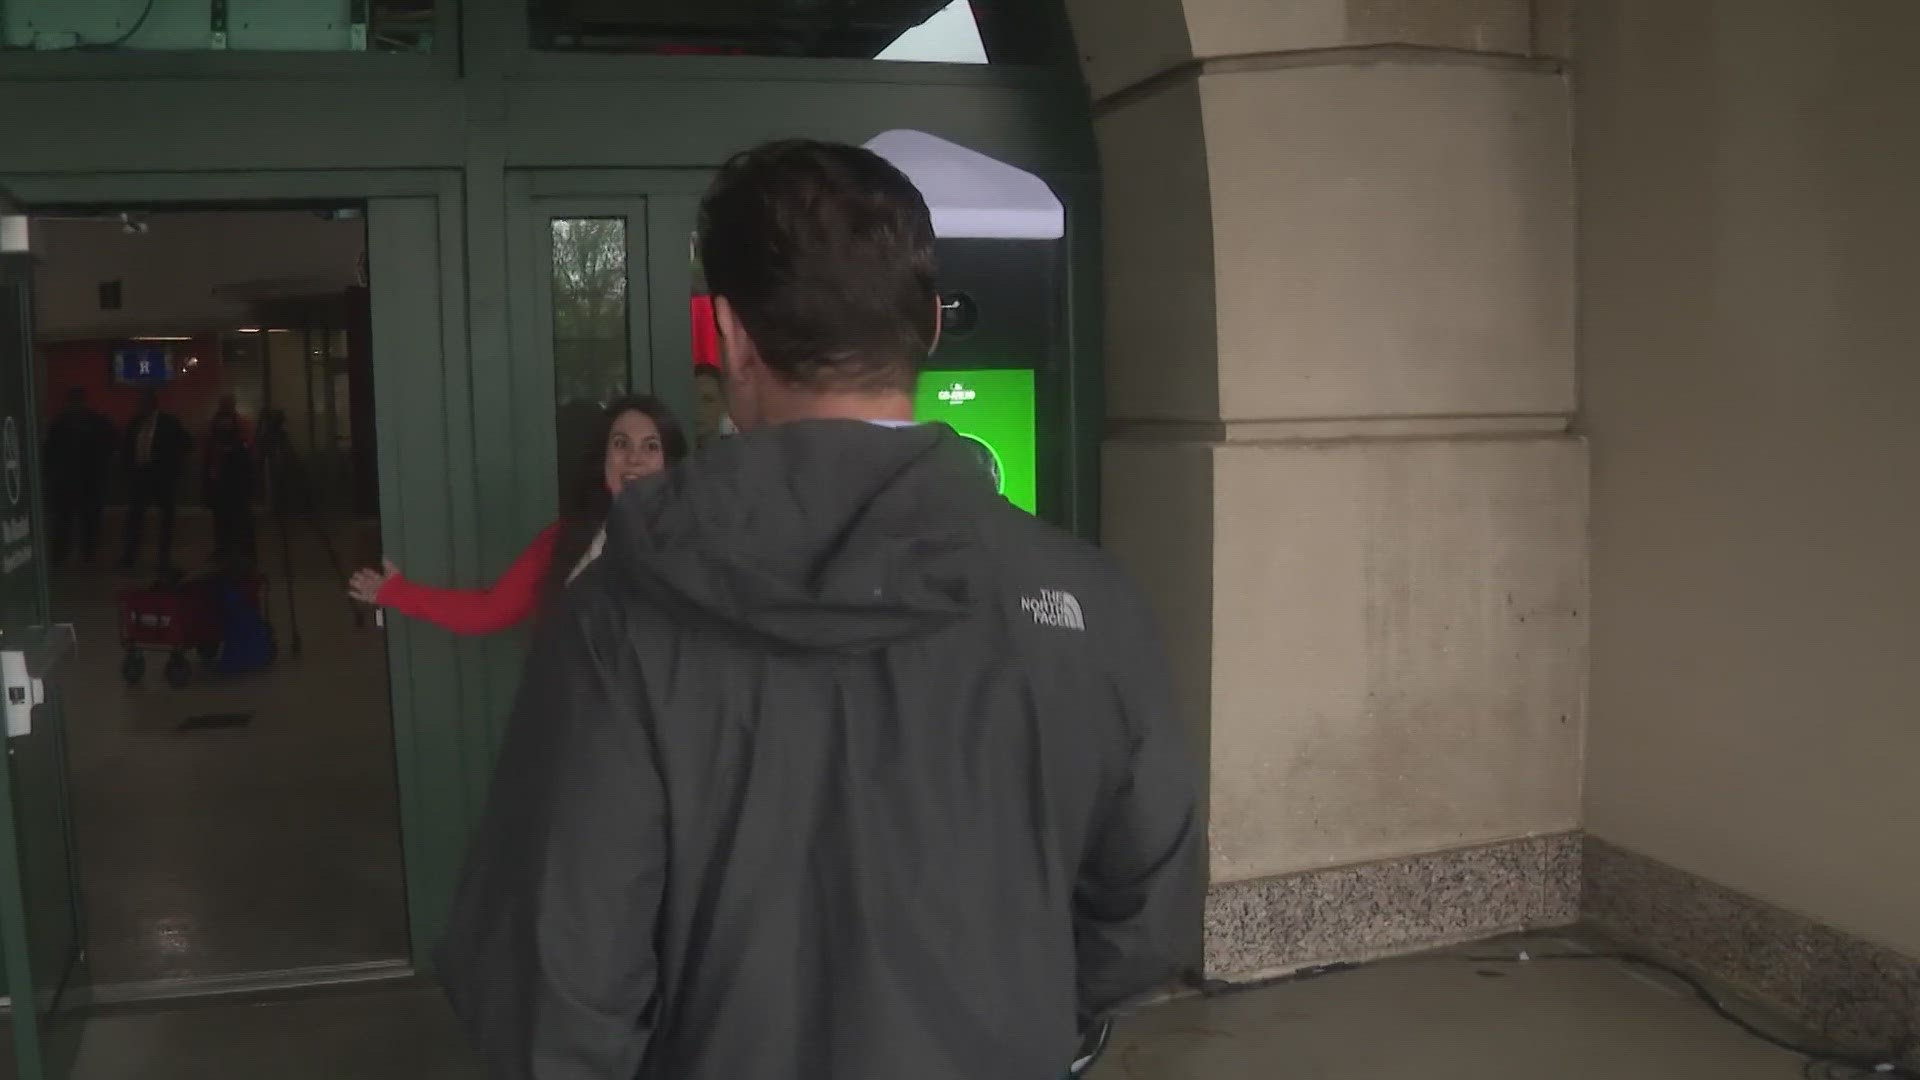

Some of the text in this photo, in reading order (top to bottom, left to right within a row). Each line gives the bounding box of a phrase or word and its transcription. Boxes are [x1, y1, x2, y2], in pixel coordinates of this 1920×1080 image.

[1040, 588, 1063, 602] THE
[1021, 596, 1064, 614] NORTH
[1032, 608, 1065, 626] FACE
